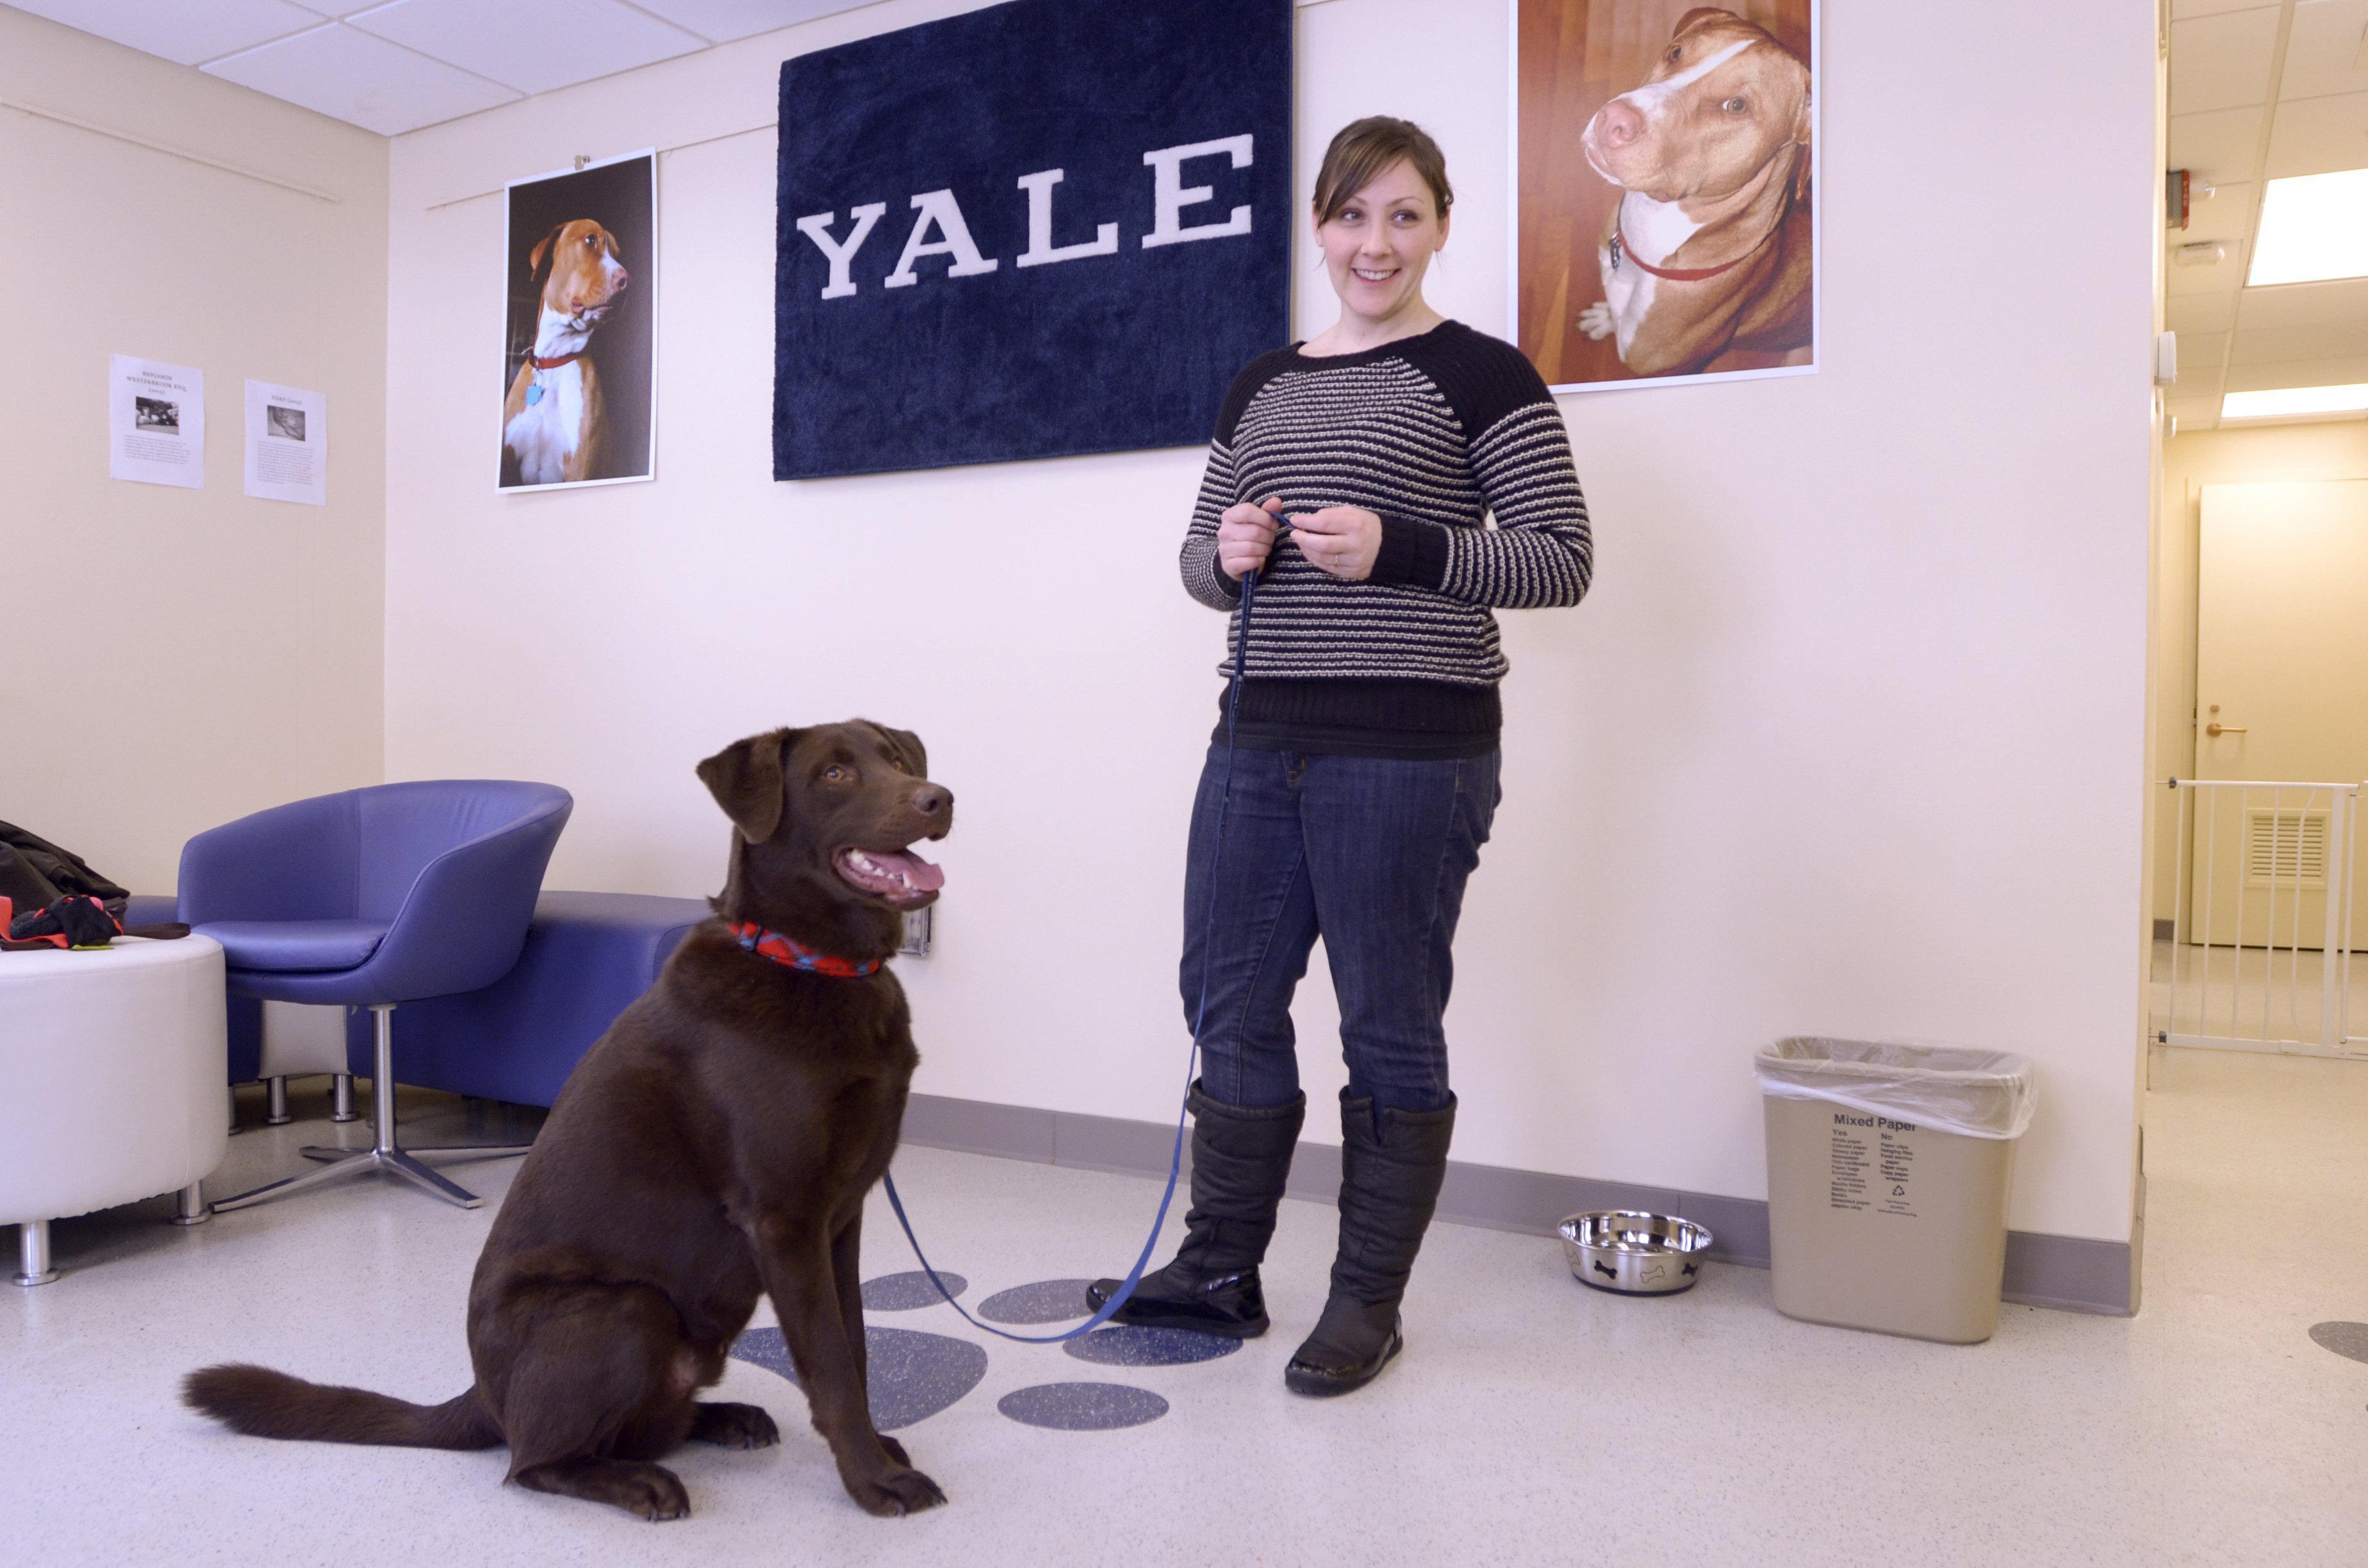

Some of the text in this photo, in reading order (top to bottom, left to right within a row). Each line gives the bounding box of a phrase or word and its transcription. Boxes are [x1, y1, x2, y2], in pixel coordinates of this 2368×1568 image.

[796, 133, 1253, 300] YALE
[142, 371, 173, 381] BENJAMIN
[1834, 1114, 1916, 1132] Mixed Paper
